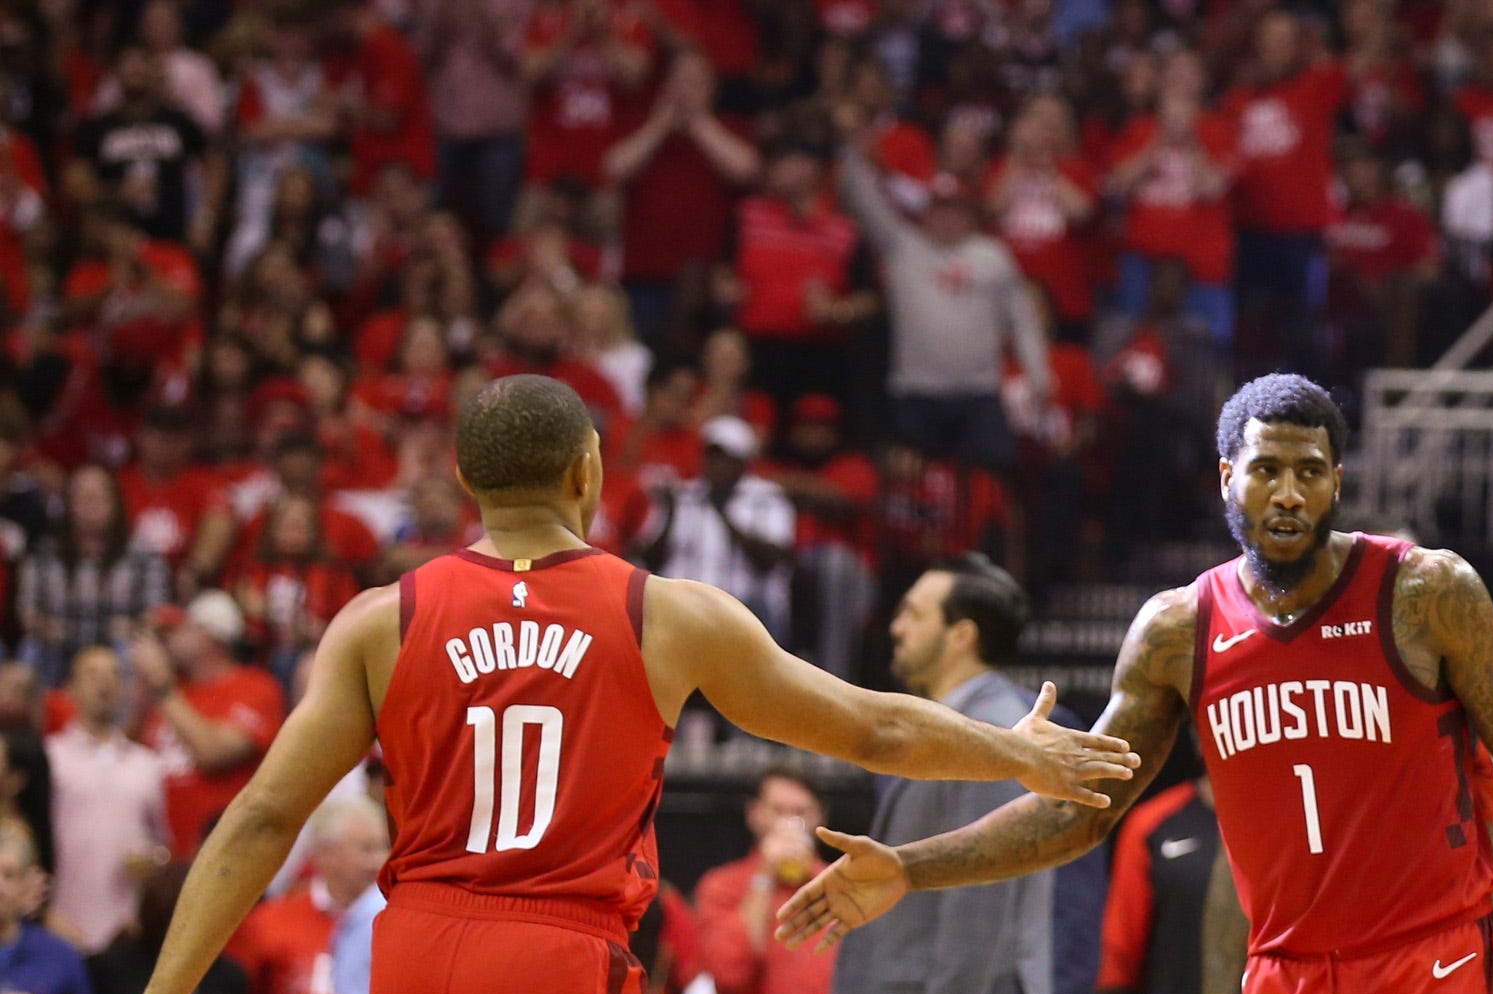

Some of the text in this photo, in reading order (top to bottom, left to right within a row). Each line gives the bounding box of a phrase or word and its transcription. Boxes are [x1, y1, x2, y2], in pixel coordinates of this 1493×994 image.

[445, 620, 593, 684] GORDON
[1207, 679, 1392, 760] HOUSTON
[465, 704, 564, 854] 10
[1293, 763, 1324, 854] 1
